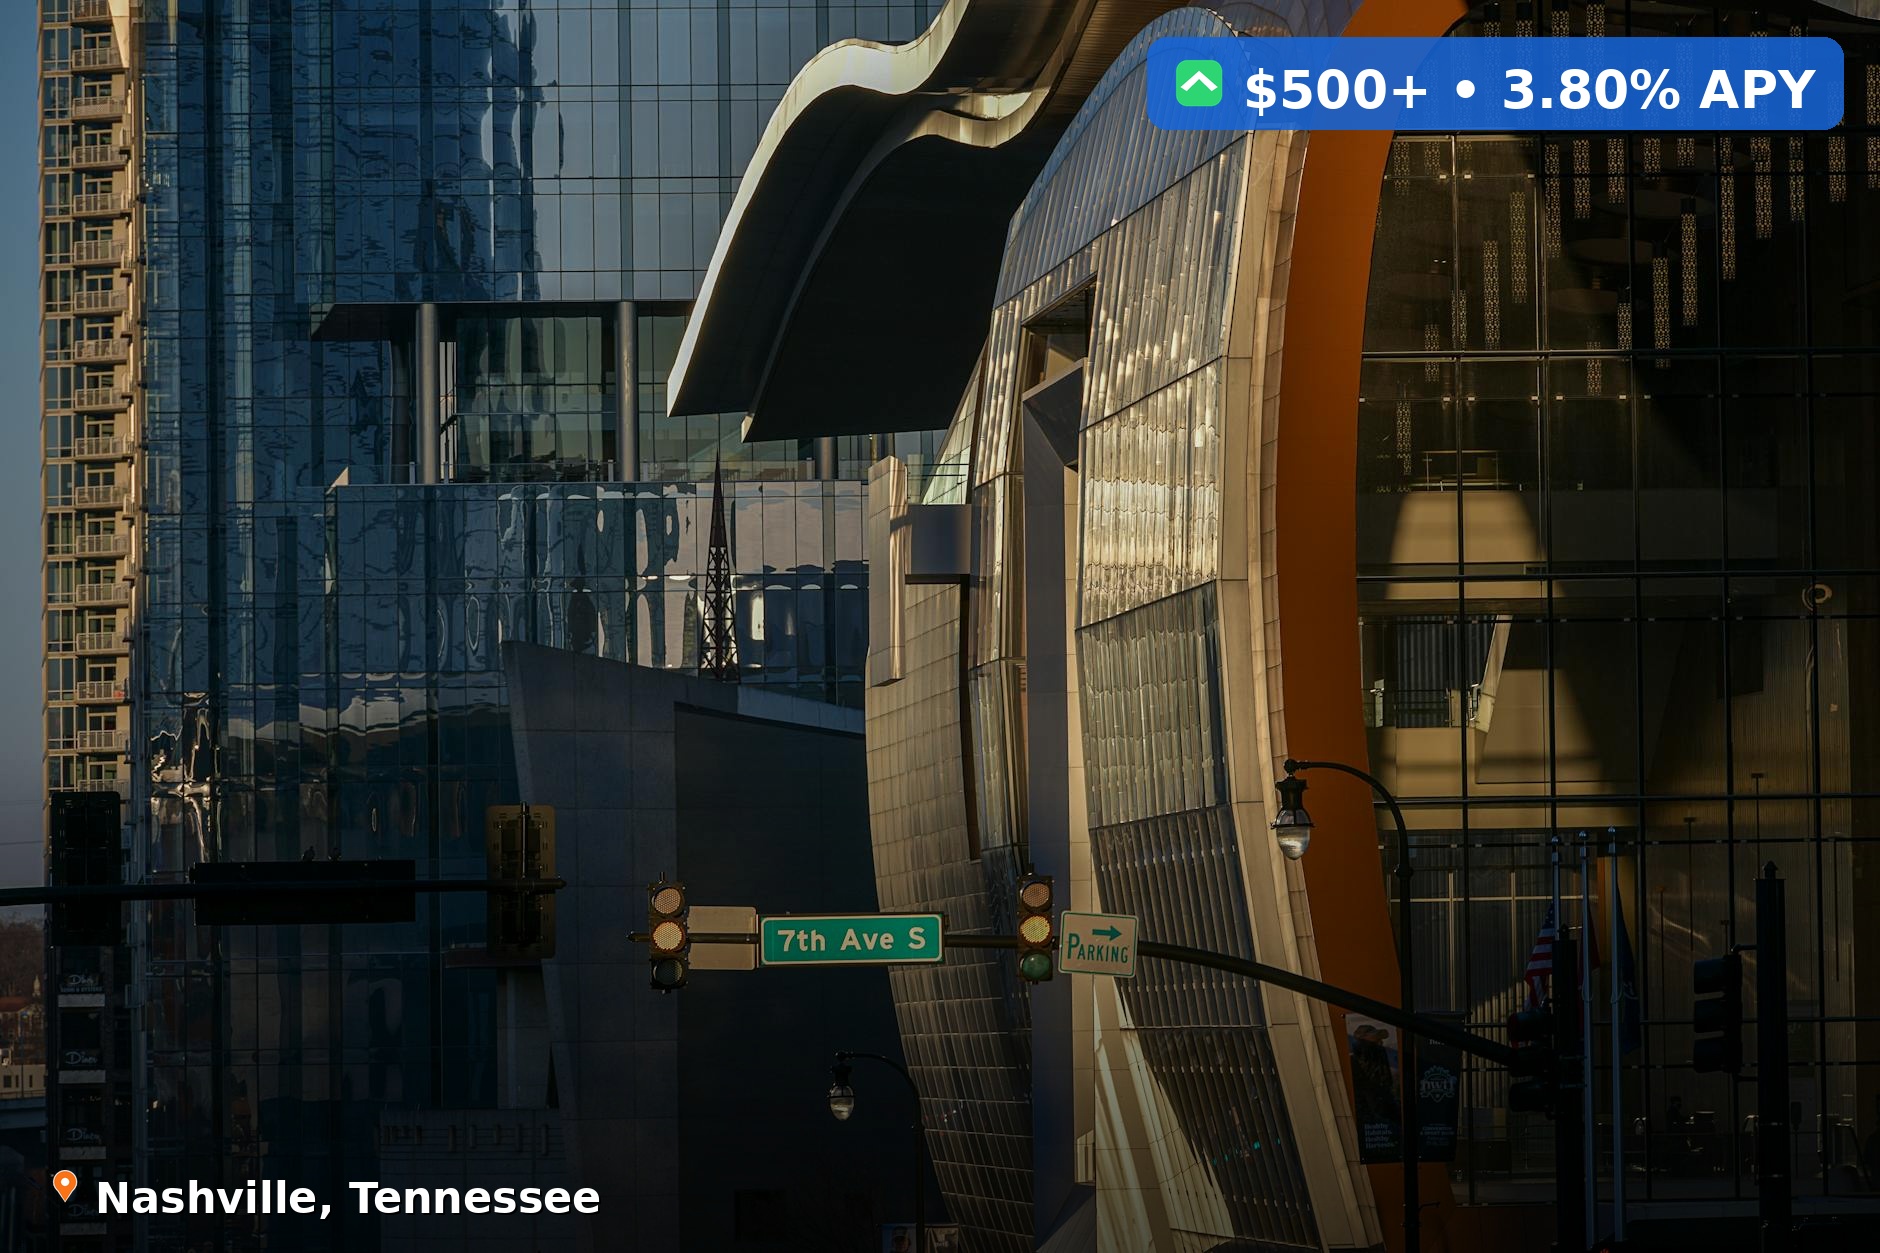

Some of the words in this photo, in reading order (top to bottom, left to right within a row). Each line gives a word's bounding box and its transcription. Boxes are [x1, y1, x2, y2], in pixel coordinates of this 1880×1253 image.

[777, 929, 826, 952] 7th
[840, 928, 894, 951] Ave
[908, 926, 926, 950] S
[1067, 933, 1129, 963] PARKING
